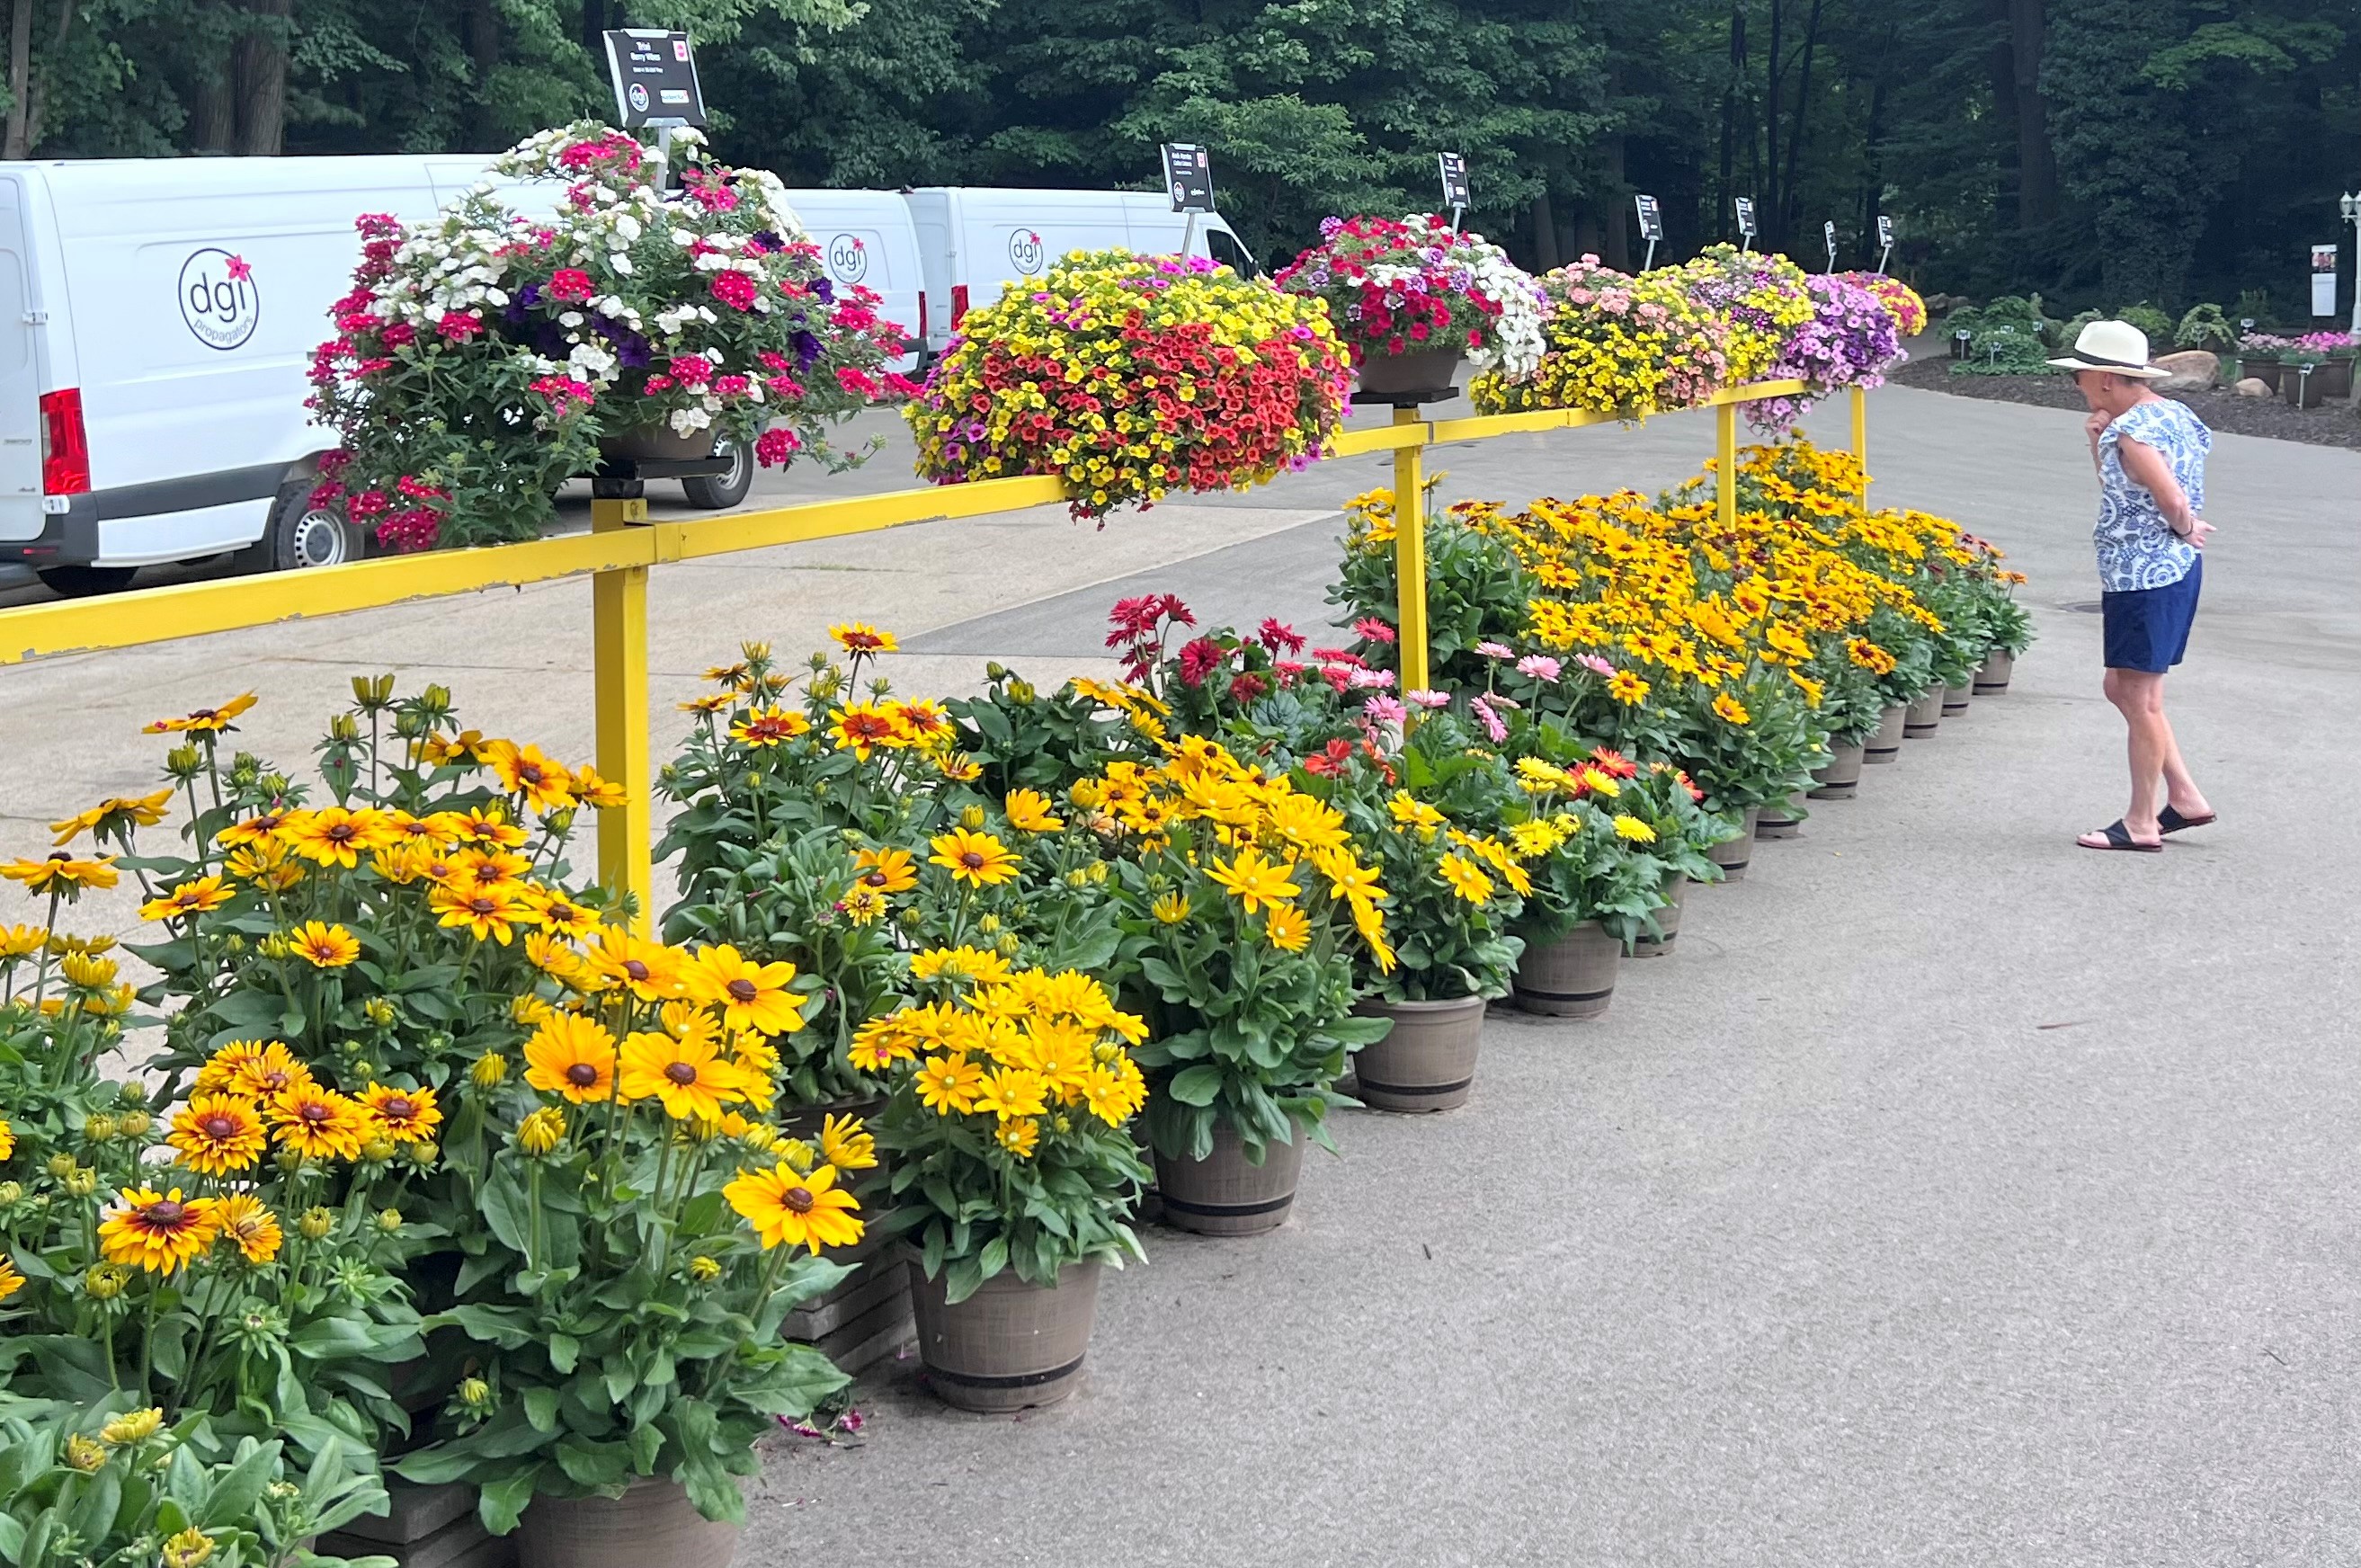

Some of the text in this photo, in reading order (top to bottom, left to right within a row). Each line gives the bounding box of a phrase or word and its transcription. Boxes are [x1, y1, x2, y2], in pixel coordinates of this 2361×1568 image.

[834, 245, 861, 272] dgi
[1013, 238, 1038, 263] dgi
[190, 272, 246, 323] dgi
[194, 316, 253, 343] propagators
